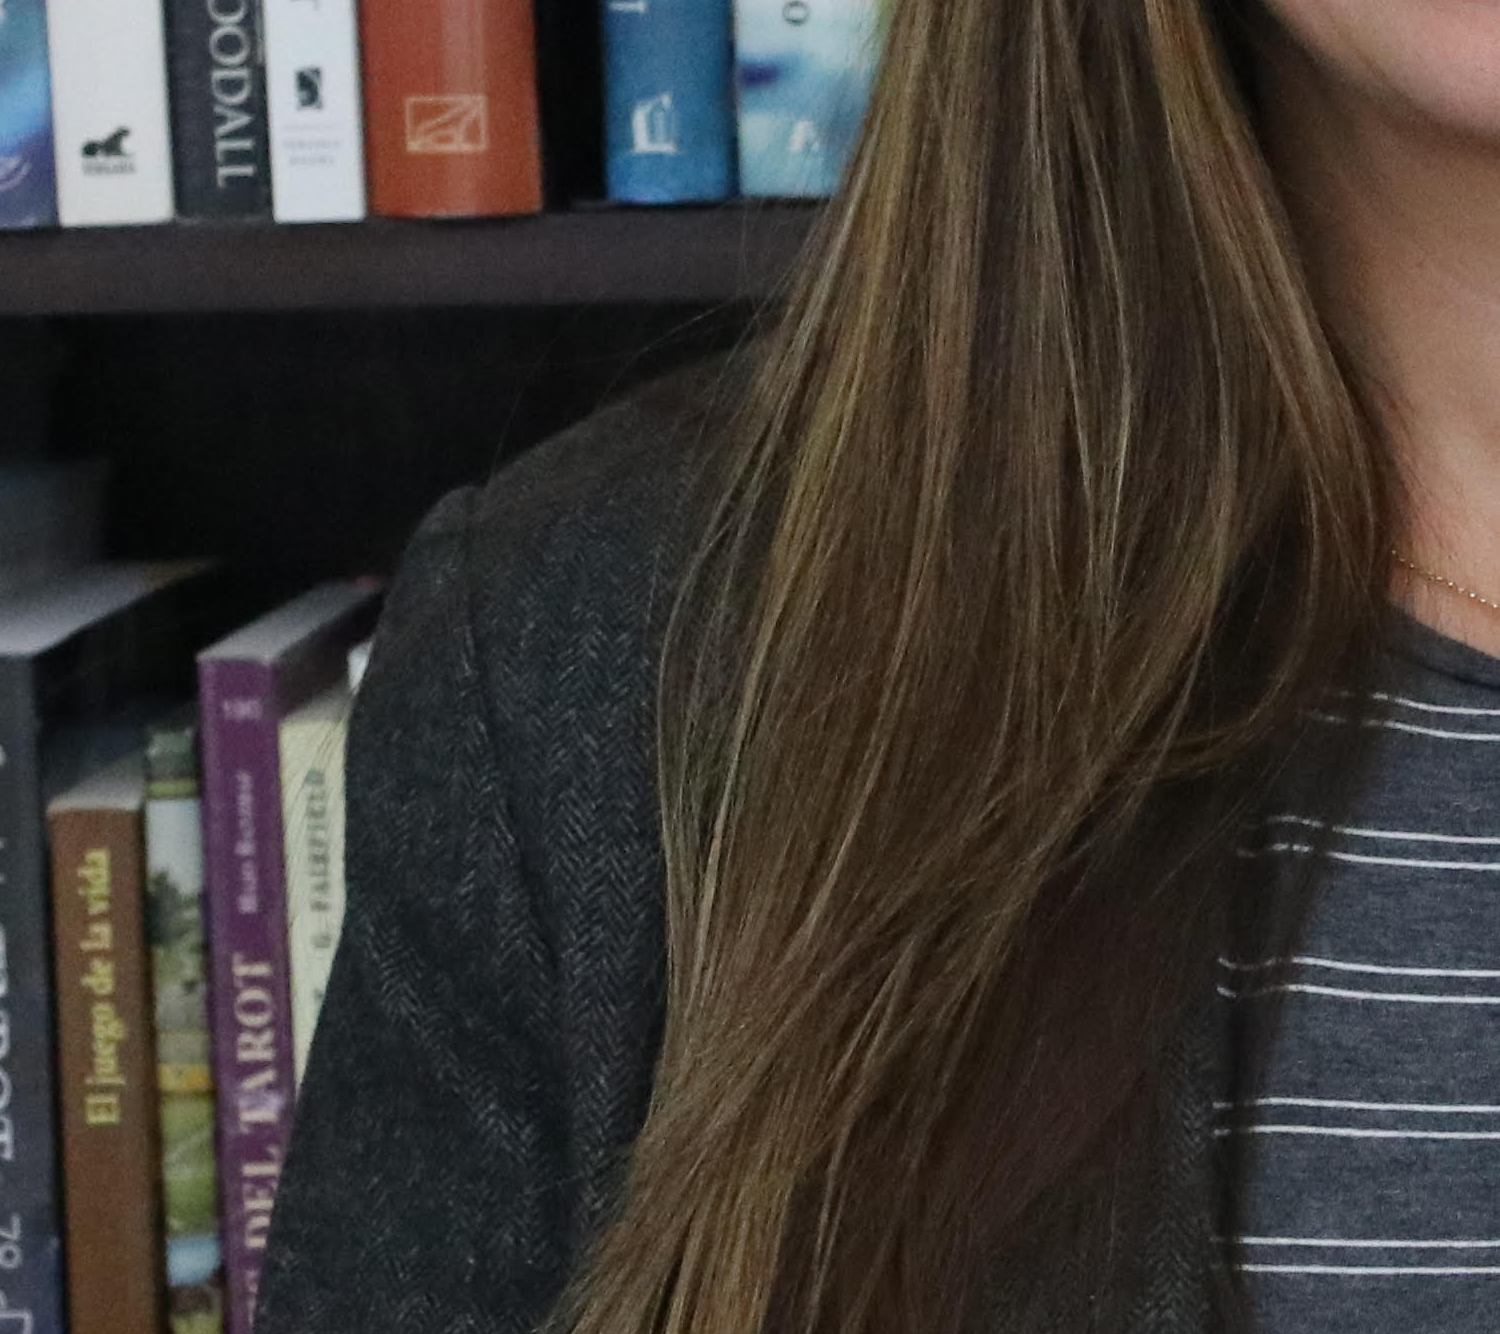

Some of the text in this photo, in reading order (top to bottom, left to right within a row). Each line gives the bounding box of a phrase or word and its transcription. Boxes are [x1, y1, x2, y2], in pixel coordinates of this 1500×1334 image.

[77, 849, 126, 1125] El juego de la vida
[232, 951, 286, 1133] TAROT
